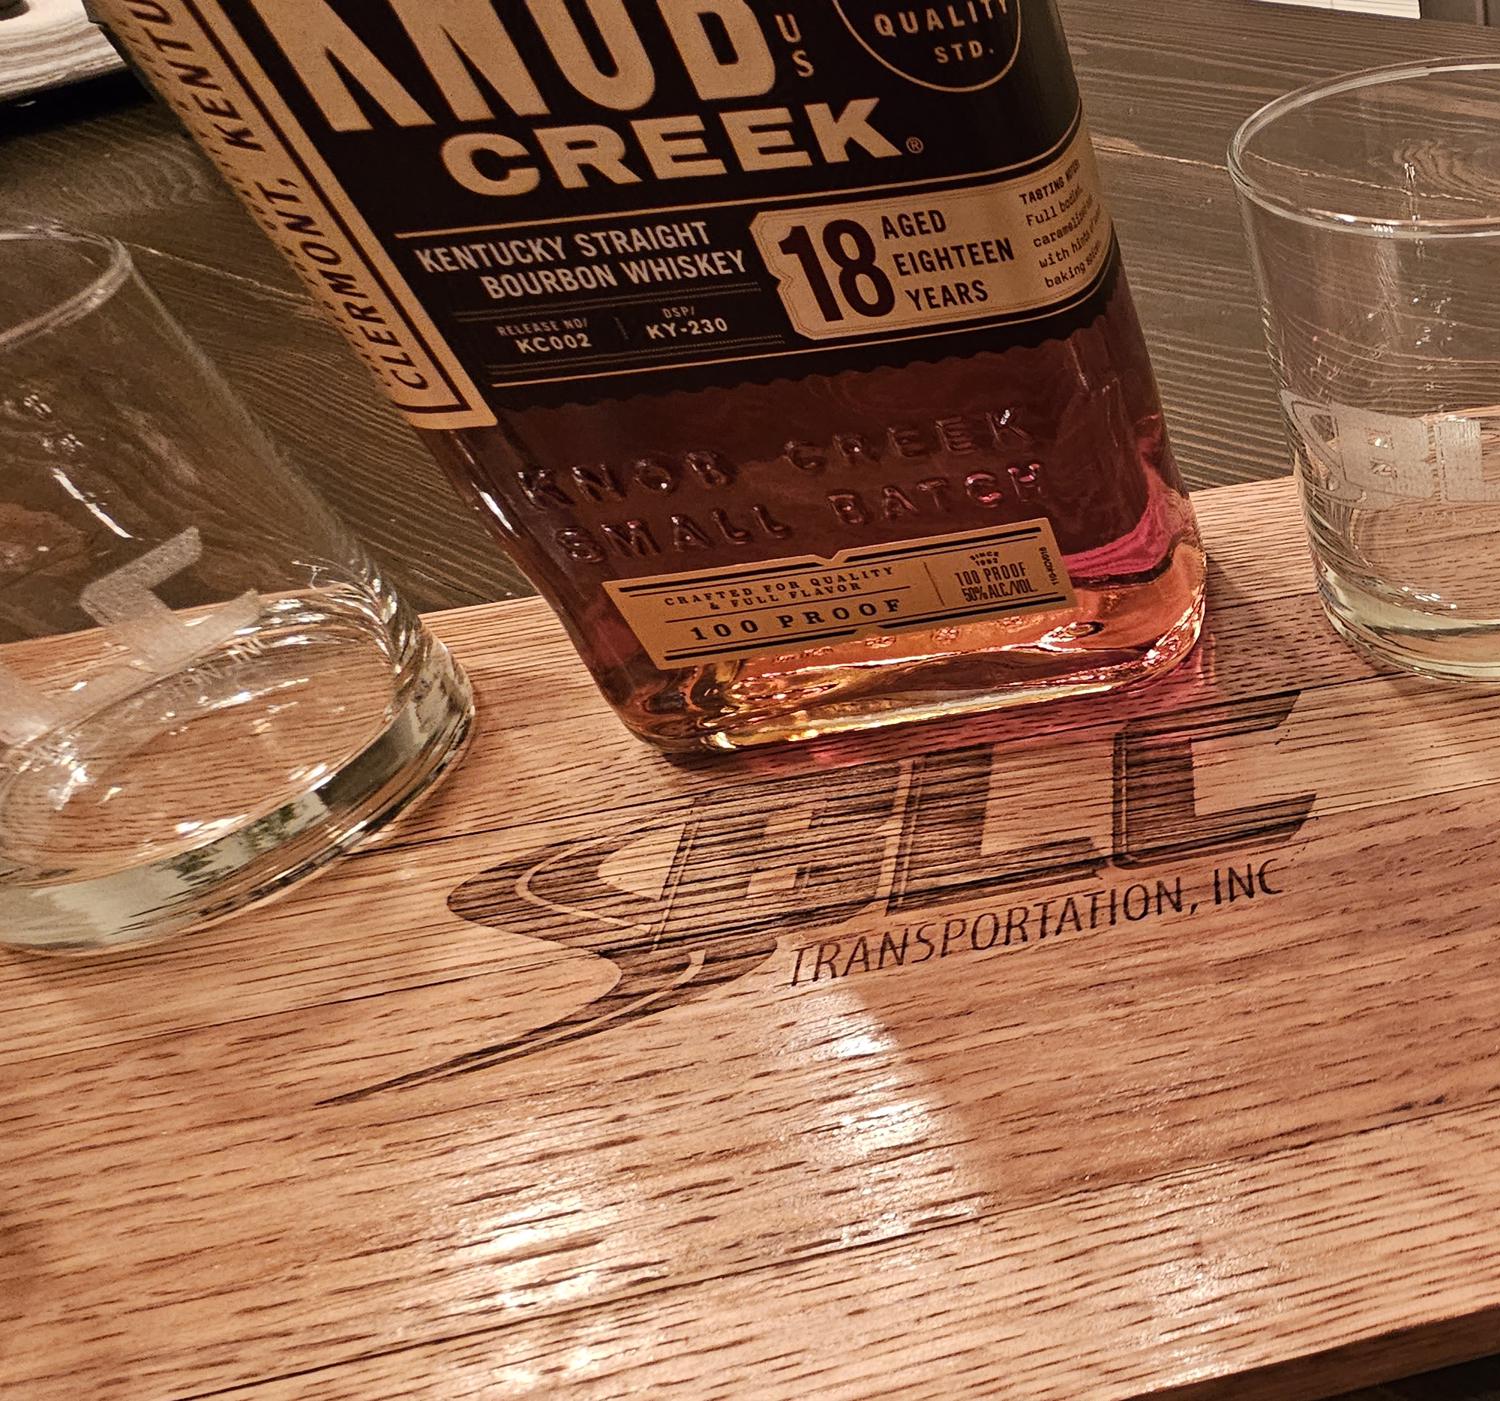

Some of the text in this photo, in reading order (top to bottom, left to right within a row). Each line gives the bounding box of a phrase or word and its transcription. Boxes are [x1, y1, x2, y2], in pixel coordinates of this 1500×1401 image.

[934, 40, 995, 64] STD.
[441, 97, 903, 196] CREEK
[1019, 176, 1065, 205] TASTING
[881, 209, 948, 239] AGED
[1025, 206, 1058, 226] Full
[415, 221, 711, 273] KENTUCKY STRAIGHT
[892, 237, 1015, 276] EIGHTEEN
[1038, 247, 1070, 268] with
[254, 178, 430, 390] CLERMONT,
[480, 249, 747, 299] BOURBON WHISKEY
[777, 219, 896, 322] 18
[1044, 261, 1086, 288] baking
[905, 280, 989, 311] YEARS
[496, 319, 557, 337] RELEASE
[515, 332, 593, 353] KC002
[645, 316, 729, 340] KY-230
[516, 407, 1034, 508] KNOB CREEK
[555, 463, 1044, 563] SMALL BATCH
[664, 566, 894, 607] CRAFTED FOR QUALITY
[955, 568, 981, 586] 100
[982, 561, 1026, 583] PROOF
[709, 582, 862, 611] & FULL FLAVOR
[961, 583, 989, 602] 50%
[690, 598, 901, 641] 100 PROOF
[789, 857, 1285, 987] TRANSPORTATION, INC
